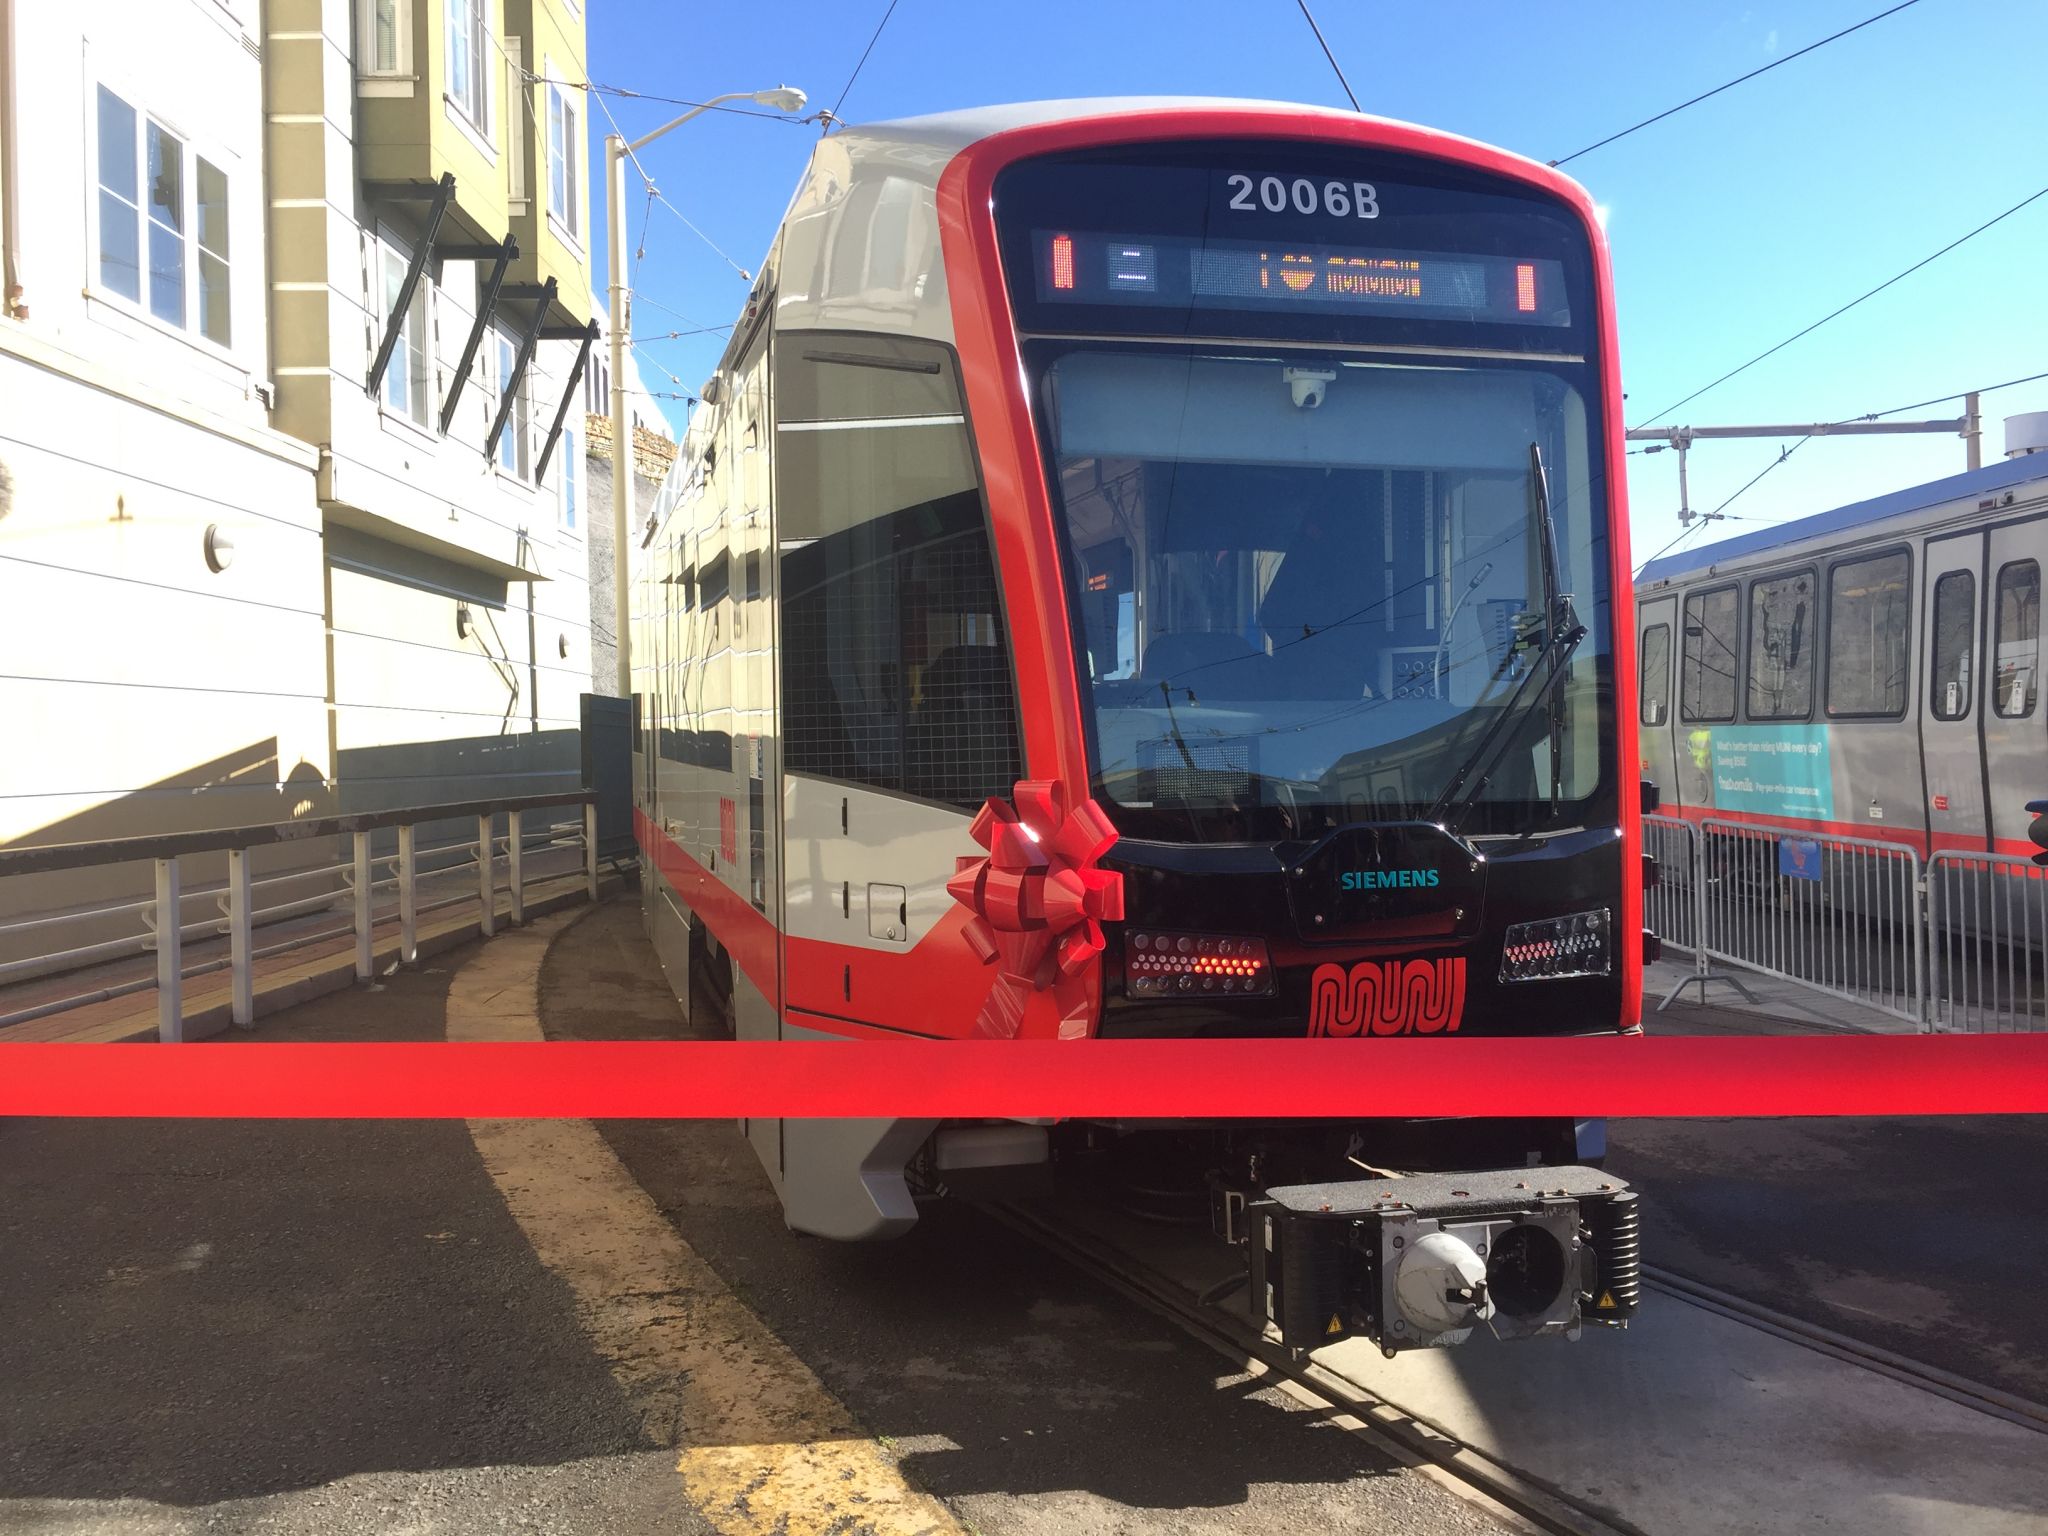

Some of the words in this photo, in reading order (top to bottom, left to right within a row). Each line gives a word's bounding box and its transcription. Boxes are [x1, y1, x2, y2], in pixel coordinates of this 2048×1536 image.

[1227, 174, 1380, 219] 2006B
[1776, 742, 1791, 753] MUNI
[1791, 744, 1807, 755] every
[1807, 742, 1822, 756] day?
[1341, 869, 1439, 890] SIEMENS
